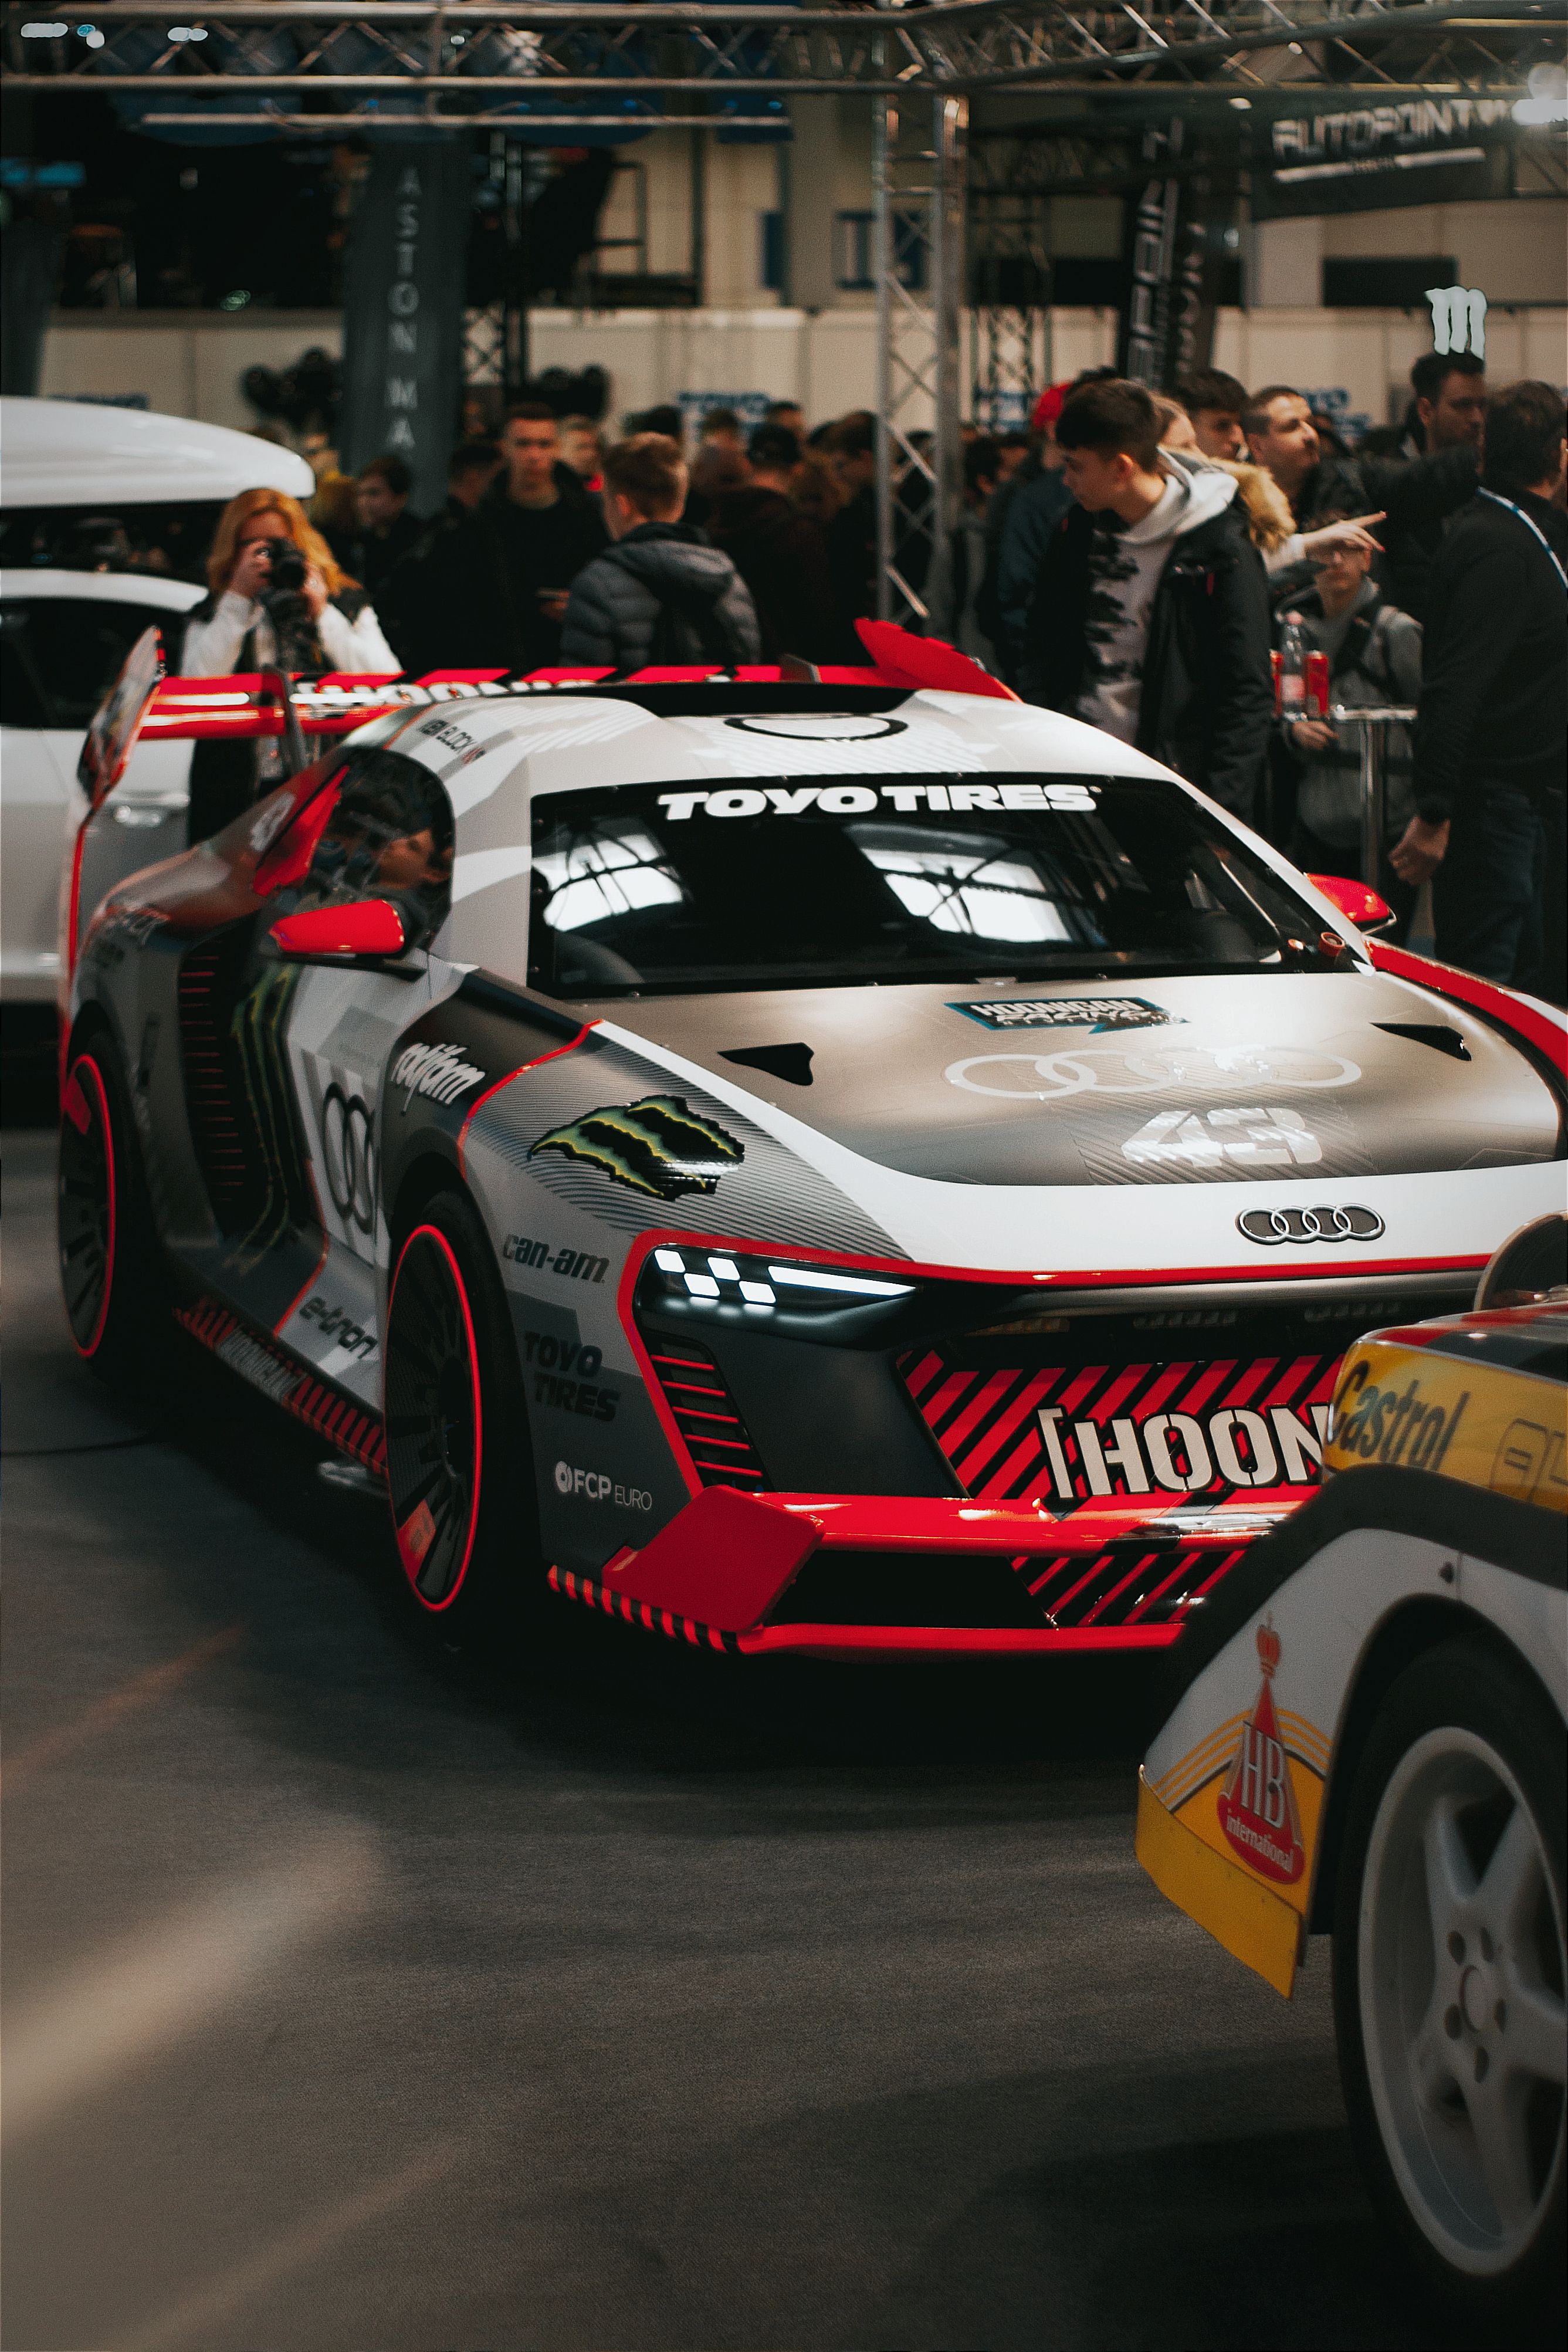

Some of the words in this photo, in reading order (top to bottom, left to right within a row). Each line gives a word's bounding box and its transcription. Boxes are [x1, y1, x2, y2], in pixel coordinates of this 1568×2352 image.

[387, 167, 422, 352] ASTON
[657, 786, 878, 820] TOYO
[881, 784, 1096, 811] TIRES
[970, 999, 1144, 1016] HOONIGAN
[1120, 1107, 1323, 1167] 43
[503, 1233, 610, 1284] can-am
[299, 1297, 378, 1359] e-tron
[525, 1330, 604, 1378] TOYO
[533, 1370, 620, 1422] TIRES
[1327, 1360, 1471, 1471] Castrol
[574, 1468, 612, 1500] FCP
[614, 1484, 653, 1511] EURO
[1240, 1720, 1285, 1829] HB
[1226, 1807, 1295, 1874] international
